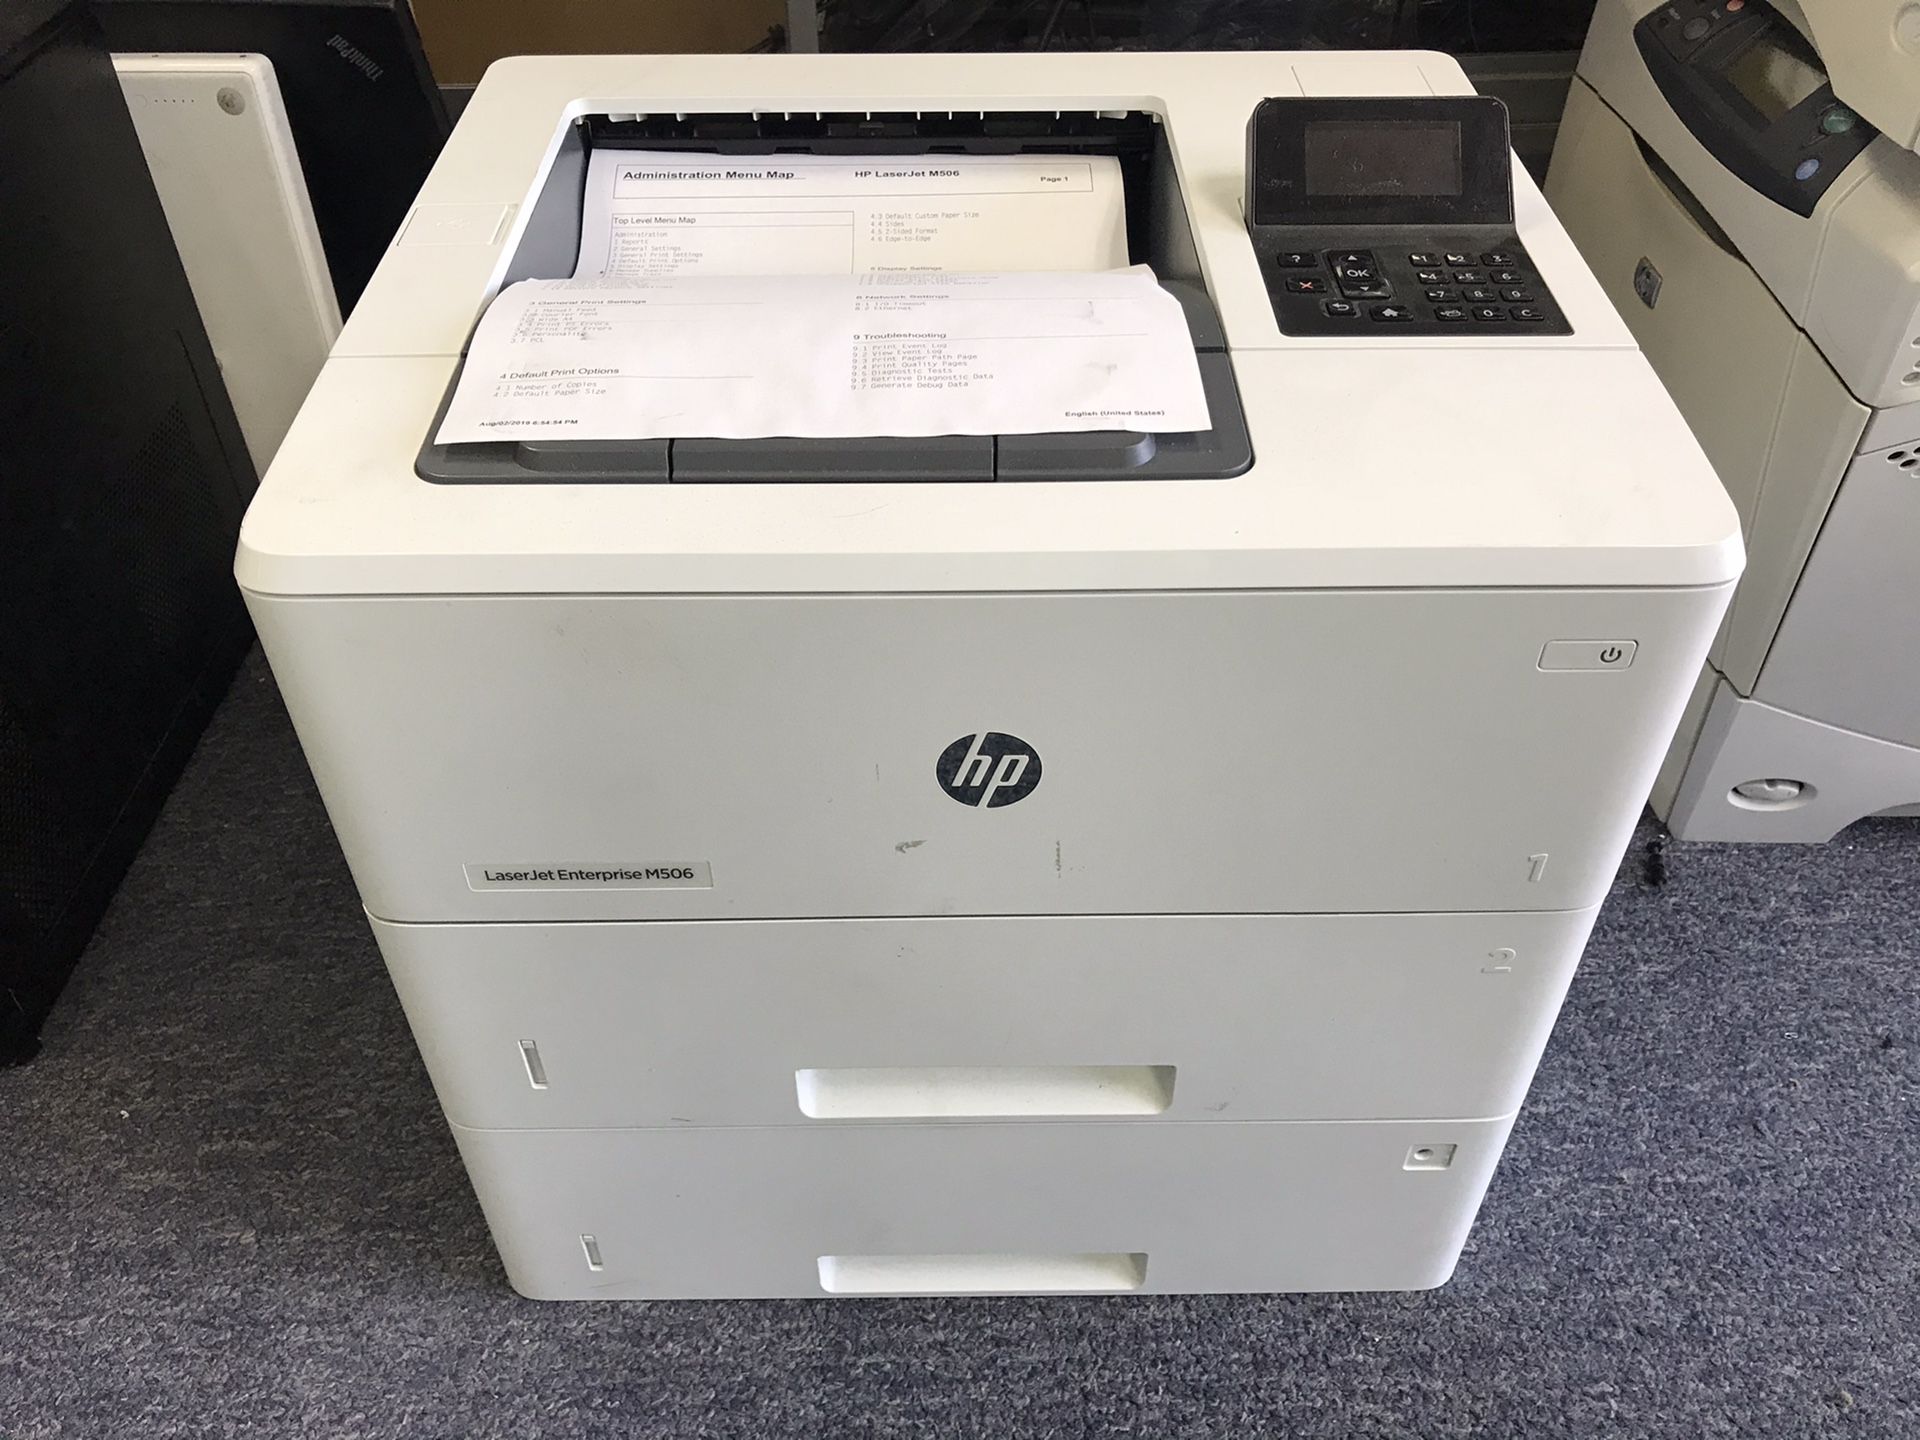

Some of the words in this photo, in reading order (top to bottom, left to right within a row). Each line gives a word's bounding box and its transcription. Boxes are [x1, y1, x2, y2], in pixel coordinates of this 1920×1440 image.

[326, 34, 384, 82] ThinkPad
[623, 171, 722, 180] Administration
[725, 171, 762, 179] Menu
[766, 171, 795, 181] Map
[875, 170, 926, 178] LaserJet
[614, 217, 629, 225] Top
[678, 217, 696, 225] Map
[941, 212, 961, 220] Paper
[884, 235, 931, 243] Edge-to-Edge
[1346, 268, 1370, 278] OK
[1502, 272, 1512, 280] 6
[1482, 309, 1494, 318] 0
[1520, 309, 1532, 317] C
[510, 371, 548, 379] Default
[578, 368, 620, 376] Options
[947, 732, 1033, 807] hp
[1527, 852, 1549, 882] 1
[484, 869, 555, 882] LaserJet
[557, 869, 642, 882] Enterprise
[645, 868, 694, 880] M506
[1480, 946, 1517, 975] 2
